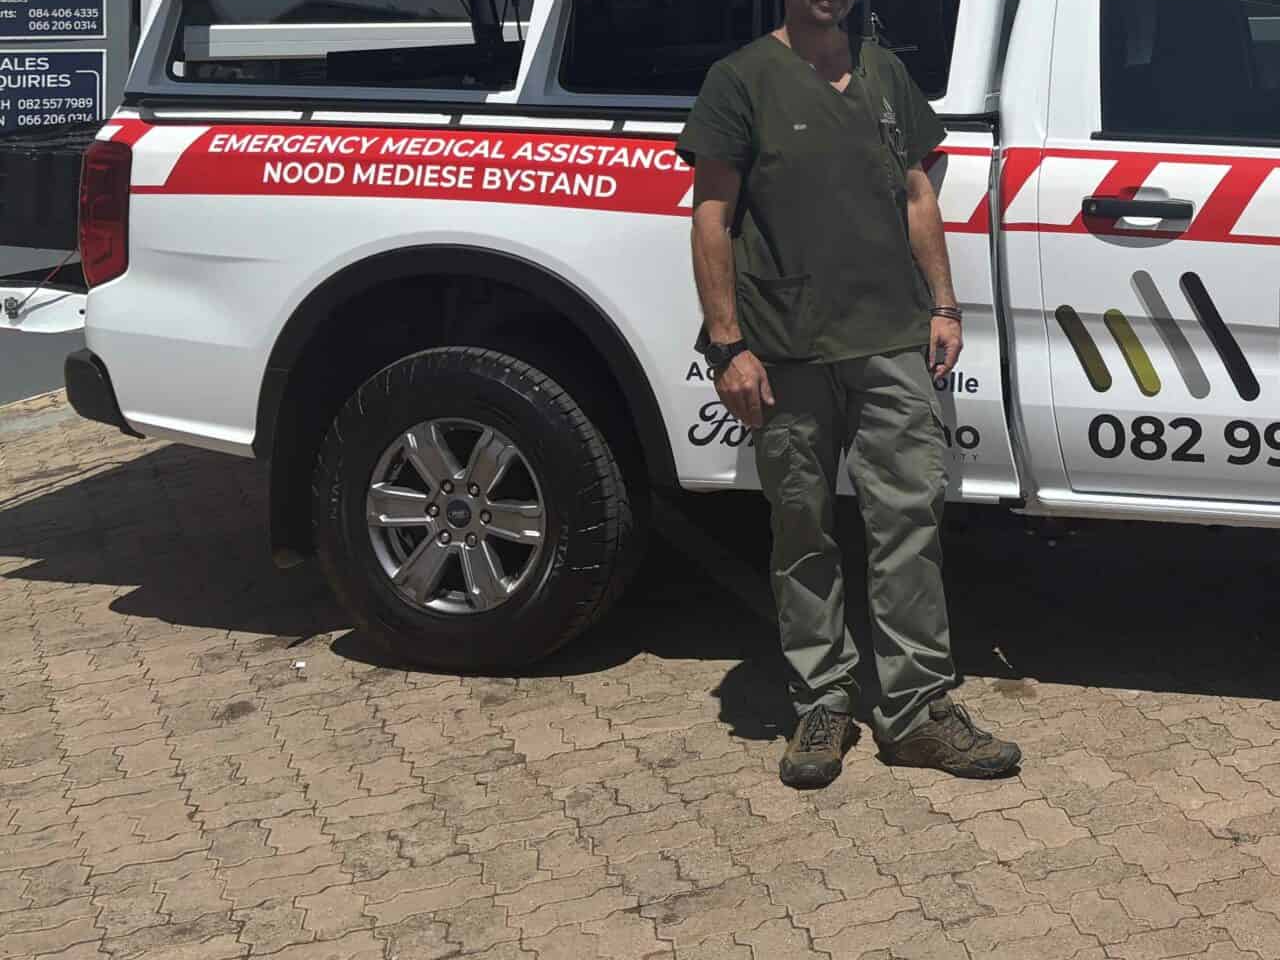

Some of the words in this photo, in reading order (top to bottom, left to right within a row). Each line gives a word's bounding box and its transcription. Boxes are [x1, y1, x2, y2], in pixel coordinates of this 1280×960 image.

[28, 8, 49, 18] 084
[51, 8, 72, 18] 406
[73, 8, 98, 18] 4335
[28, 21, 49, 31] 066
[51, 21, 72, 30] 206
[74, 20, 97, 30] 0314
[18, 99, 40, 110] 082
[42, 98, 63, 109] 557
[63, 98, 93, 108] 7989
[18, 115, 41, 126] 066
[43, 114, 66, 125] 206
[207, 134, 380, 156] EMERGENCY
[380, 137, 505, 159] MEDICAL
[262, 161, 345, 185] NOOD
[352, 163, 473, 189] MEDIESE
[483, 168, 618, 198] BYSTAND
[1087, 413, 1206, 464] 082
